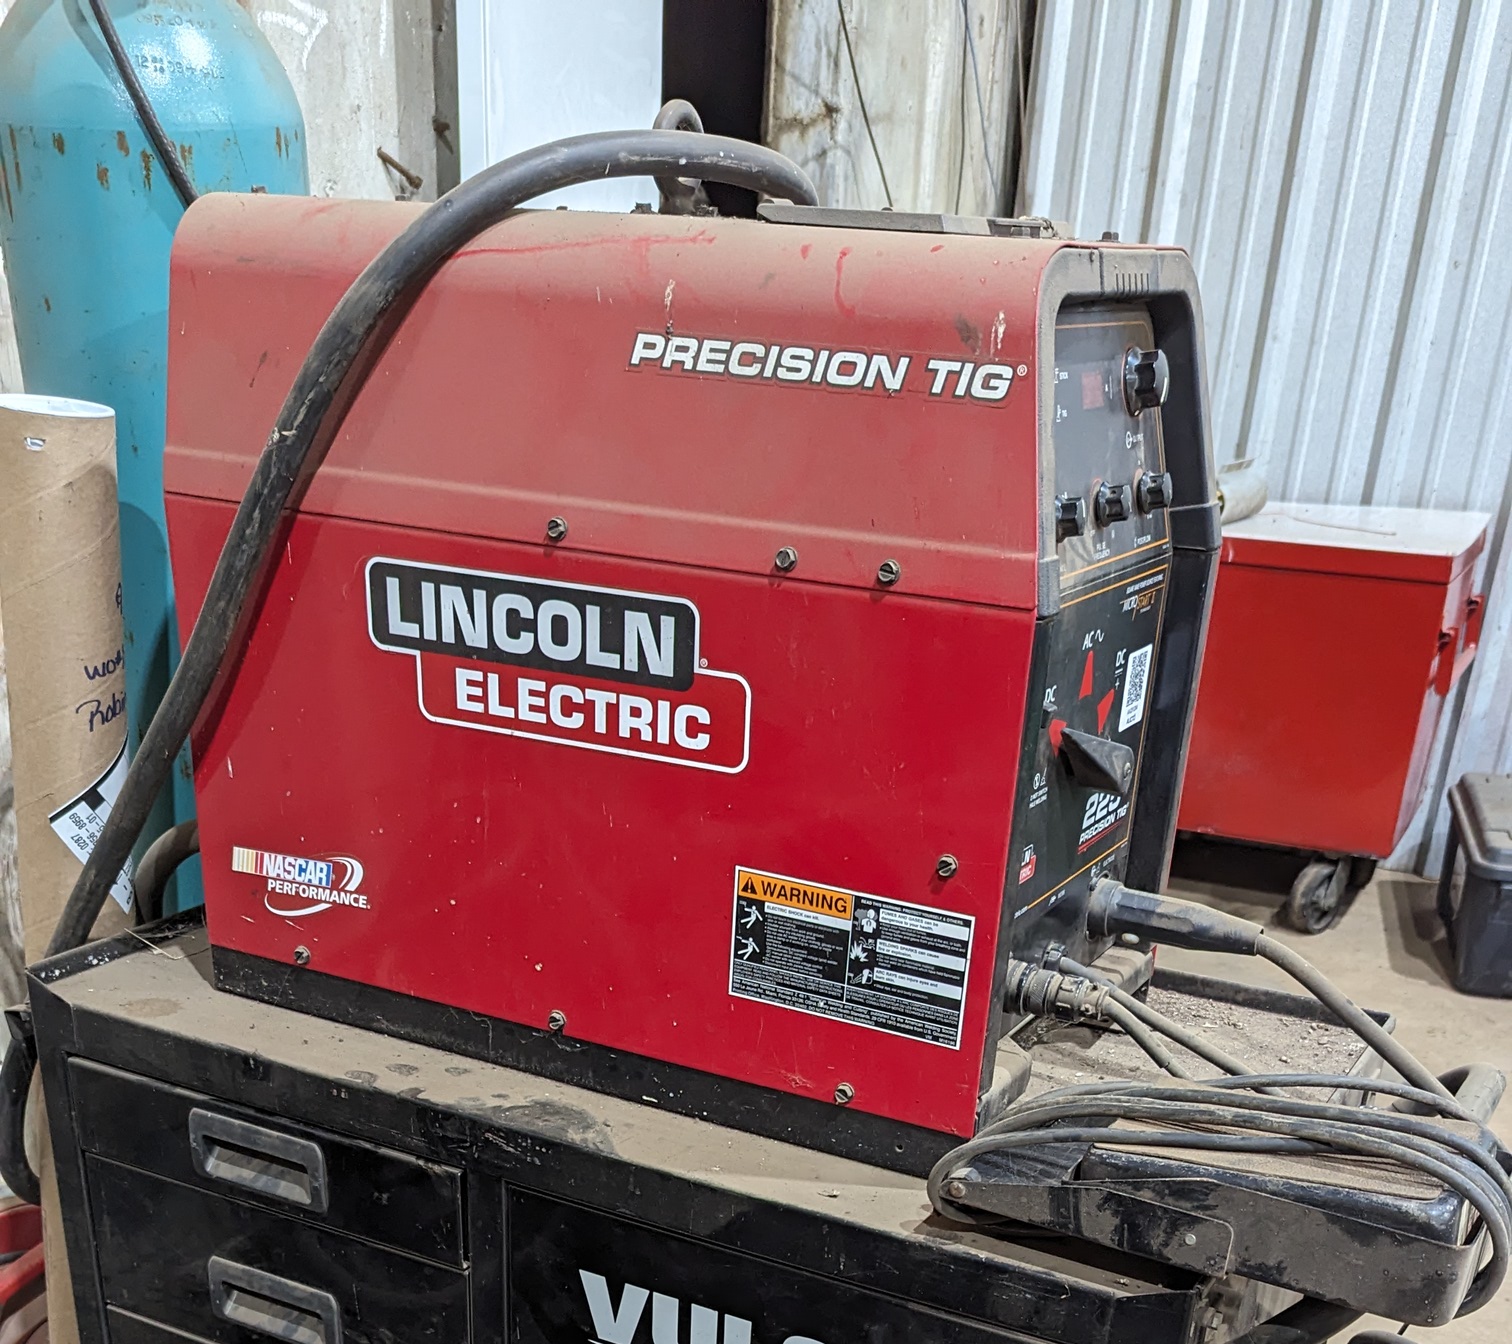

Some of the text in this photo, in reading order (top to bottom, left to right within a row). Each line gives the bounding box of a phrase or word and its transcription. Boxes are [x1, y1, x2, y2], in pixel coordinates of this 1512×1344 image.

[630, 332, 911, 391] PRECISION
[386, 576, 675, 678] LINCOLN
[1081, 630, 1095, 651] AC
[1115, 648, 1127, 667] DC
[455, 667, 711, 750] ELECTRIC
[1078, 812, 1116, 846] PRECISION
[71, 833, 89, 851] 0287
[263, 852, 328, 887] NASCAR
[268, 879, 368, 909] PERFORMANCE
[760, 880, 847, 914] WARNING
[766, 904, 787, 913] ELECTRIC
[787, 909, 803, 917] SHOCK
[881, 910, 896, 918] FUMES
[880, 915, 903, 925] dangerous
[908, 921, 919, 929] your
[878, 941, 898, 949] WELDING
[899, 946, 917, 954] SPARKS
[906, 976, 918, 984] injure
